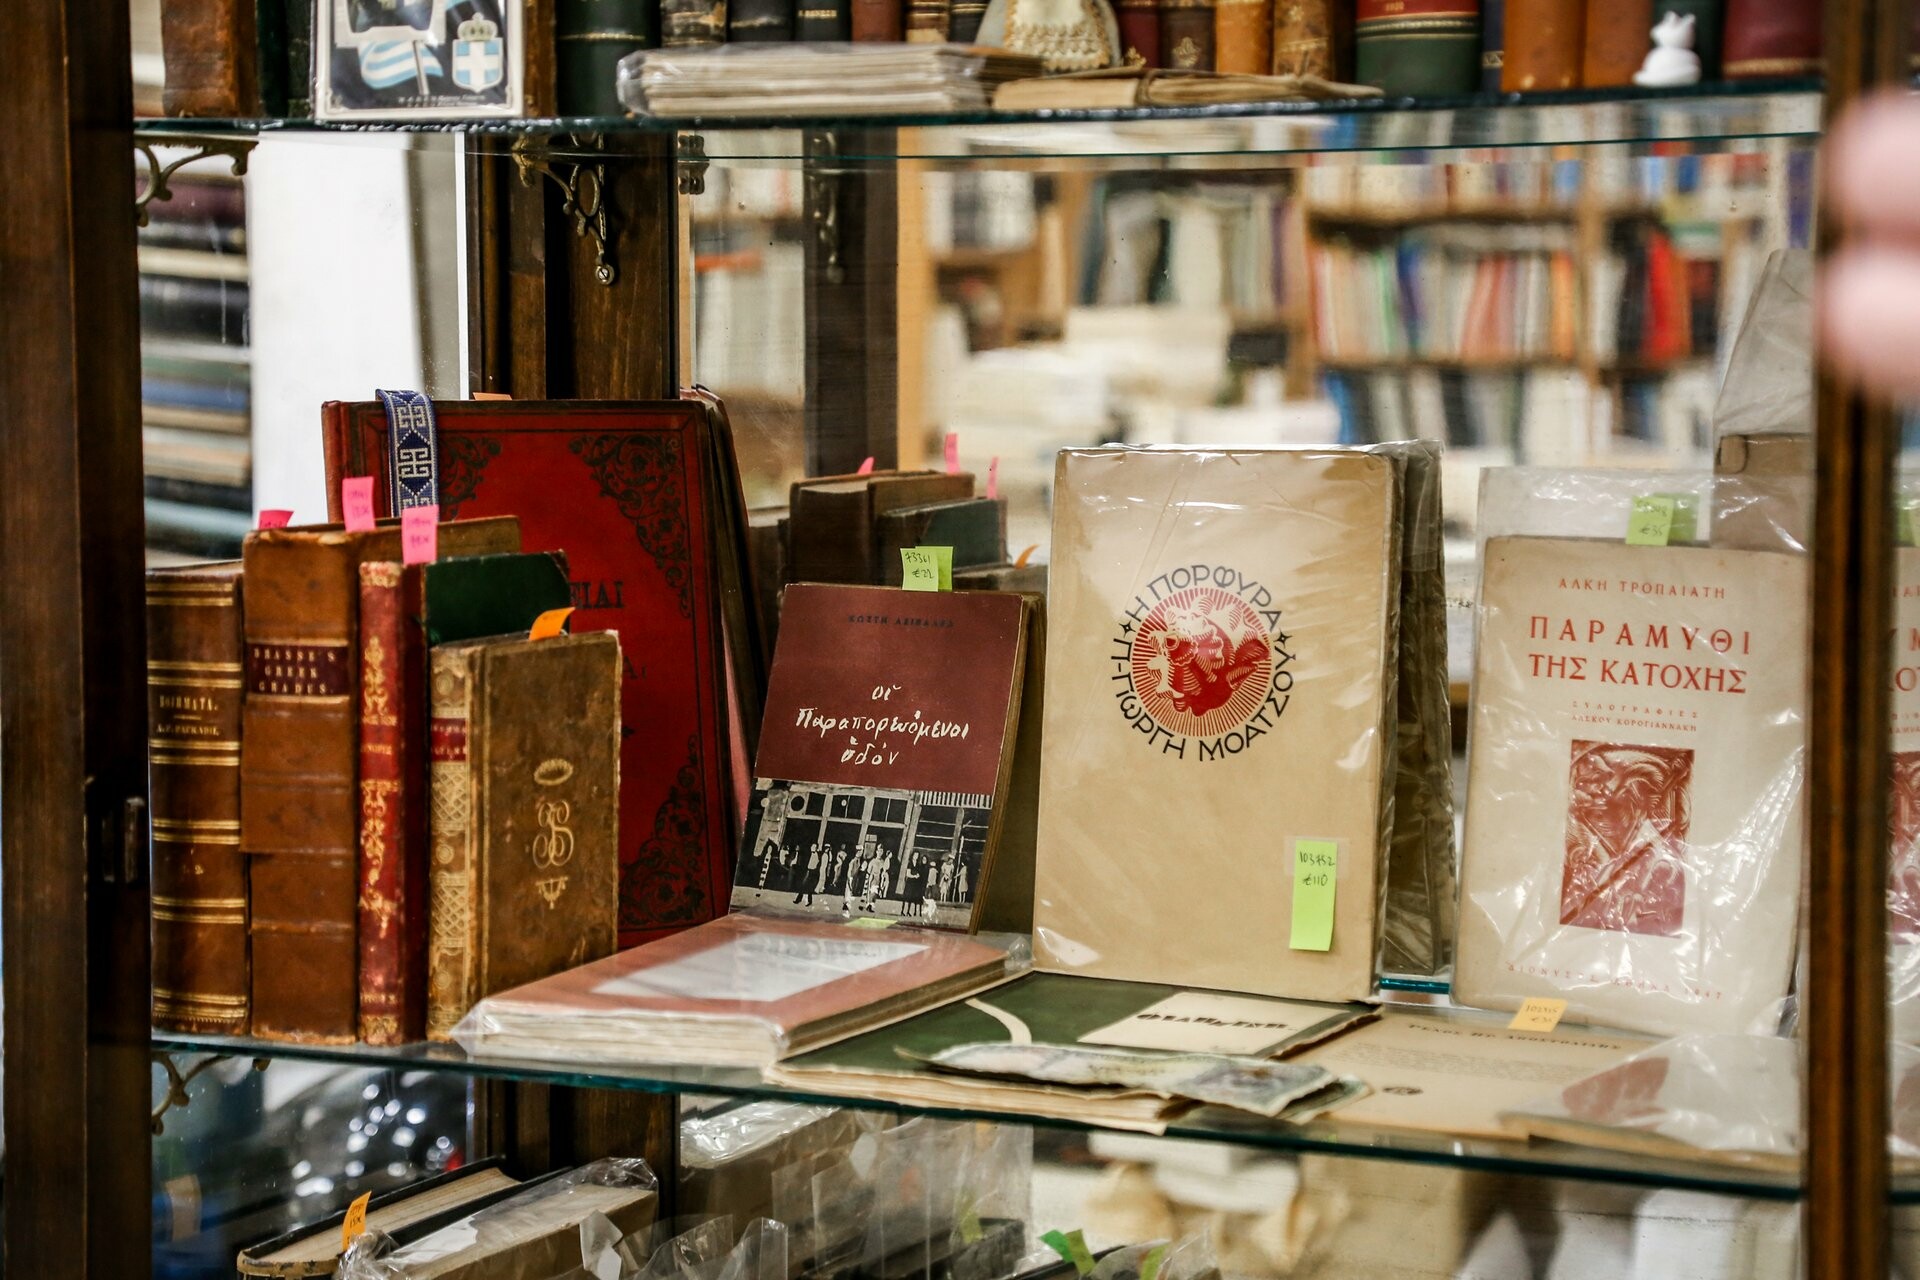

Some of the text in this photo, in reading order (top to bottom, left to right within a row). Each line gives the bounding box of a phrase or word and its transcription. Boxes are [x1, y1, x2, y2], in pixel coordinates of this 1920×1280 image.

[1125, 564, 1282, 632] Η ΠΟΡΦΥΡΑ
[1558, 577, 1726, 600] ΑΛΚΗ ΤΡΟΠΑΙΑΤΗ
[1529, 615, 1750, 655] ΠΑΡΑΜΥΘΙ
[1528, 653, 1748, 695] ΤΗΣ ΚΑΤΟΧΗΣ
[1300, 850, 1336, 867] 103752
